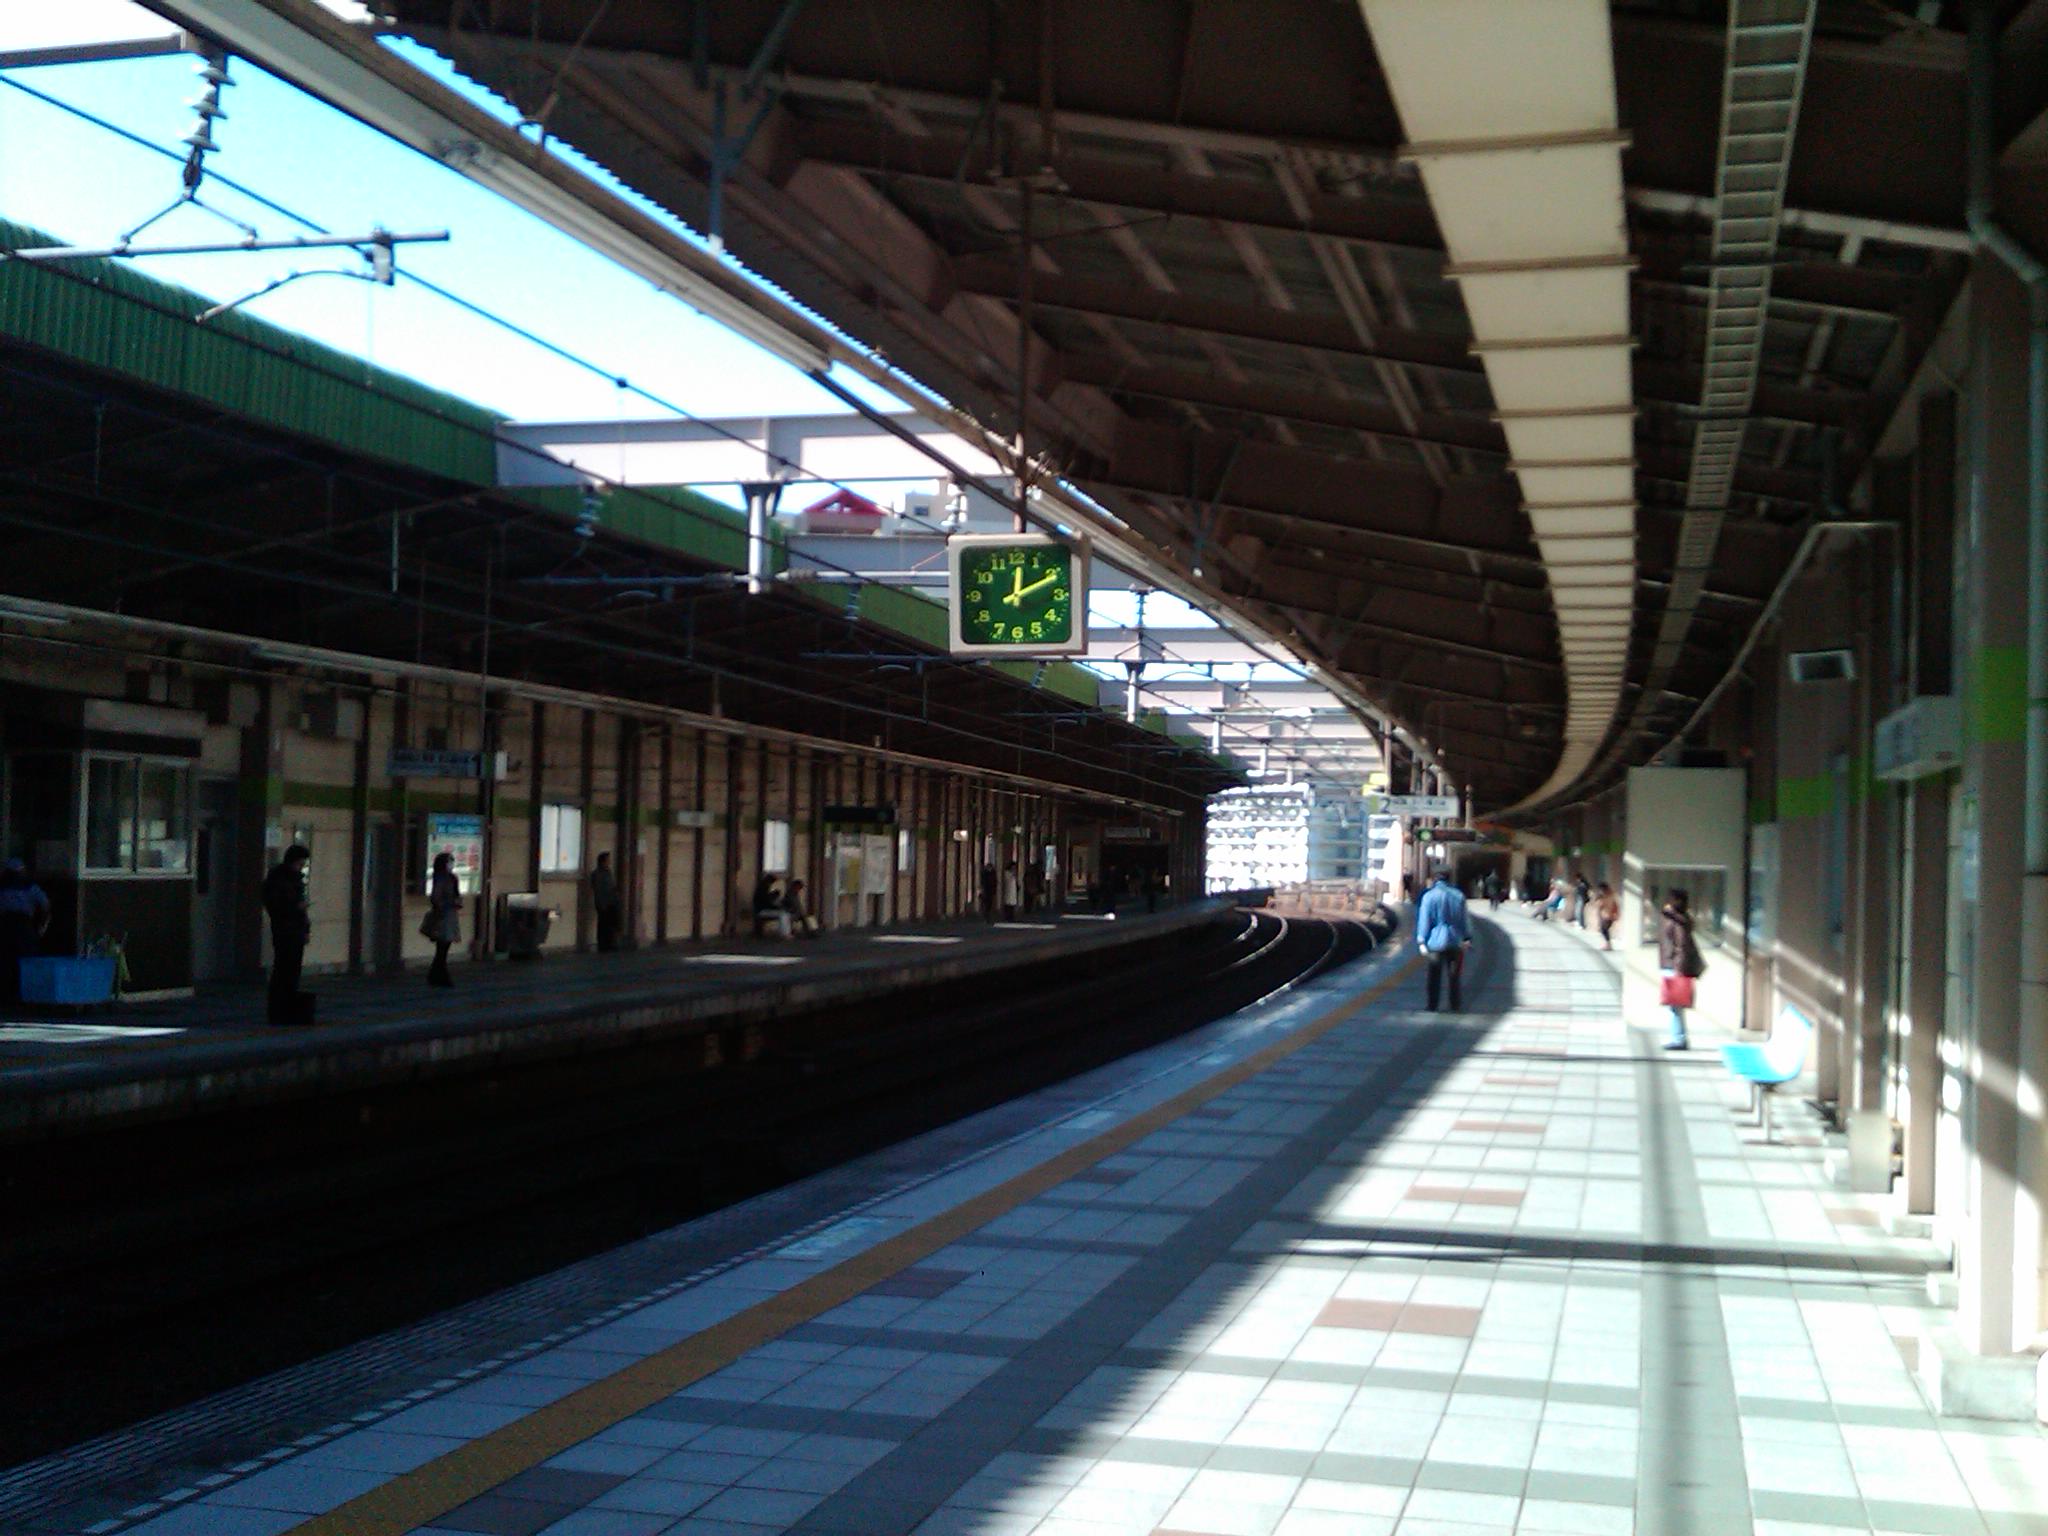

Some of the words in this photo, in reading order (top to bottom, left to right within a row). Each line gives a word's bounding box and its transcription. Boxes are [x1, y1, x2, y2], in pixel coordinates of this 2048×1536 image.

[991, 558, 1006, 570] 11
[1008, 552, 1025, 565] 12
[1032, 557, 1039, 568] 1
[977, 571, 993, 584] 10
[970, 590, 981, 602] 9
[1053, 588, 1065, 601] 3
[979, 610, 990, 622] 8
[1045, 608, 1056, 621] 4
[993, 622, 1005, 634] 7
[1011, 626, 1023, 639] 6
[1030, 622, 1042, 634] 5
